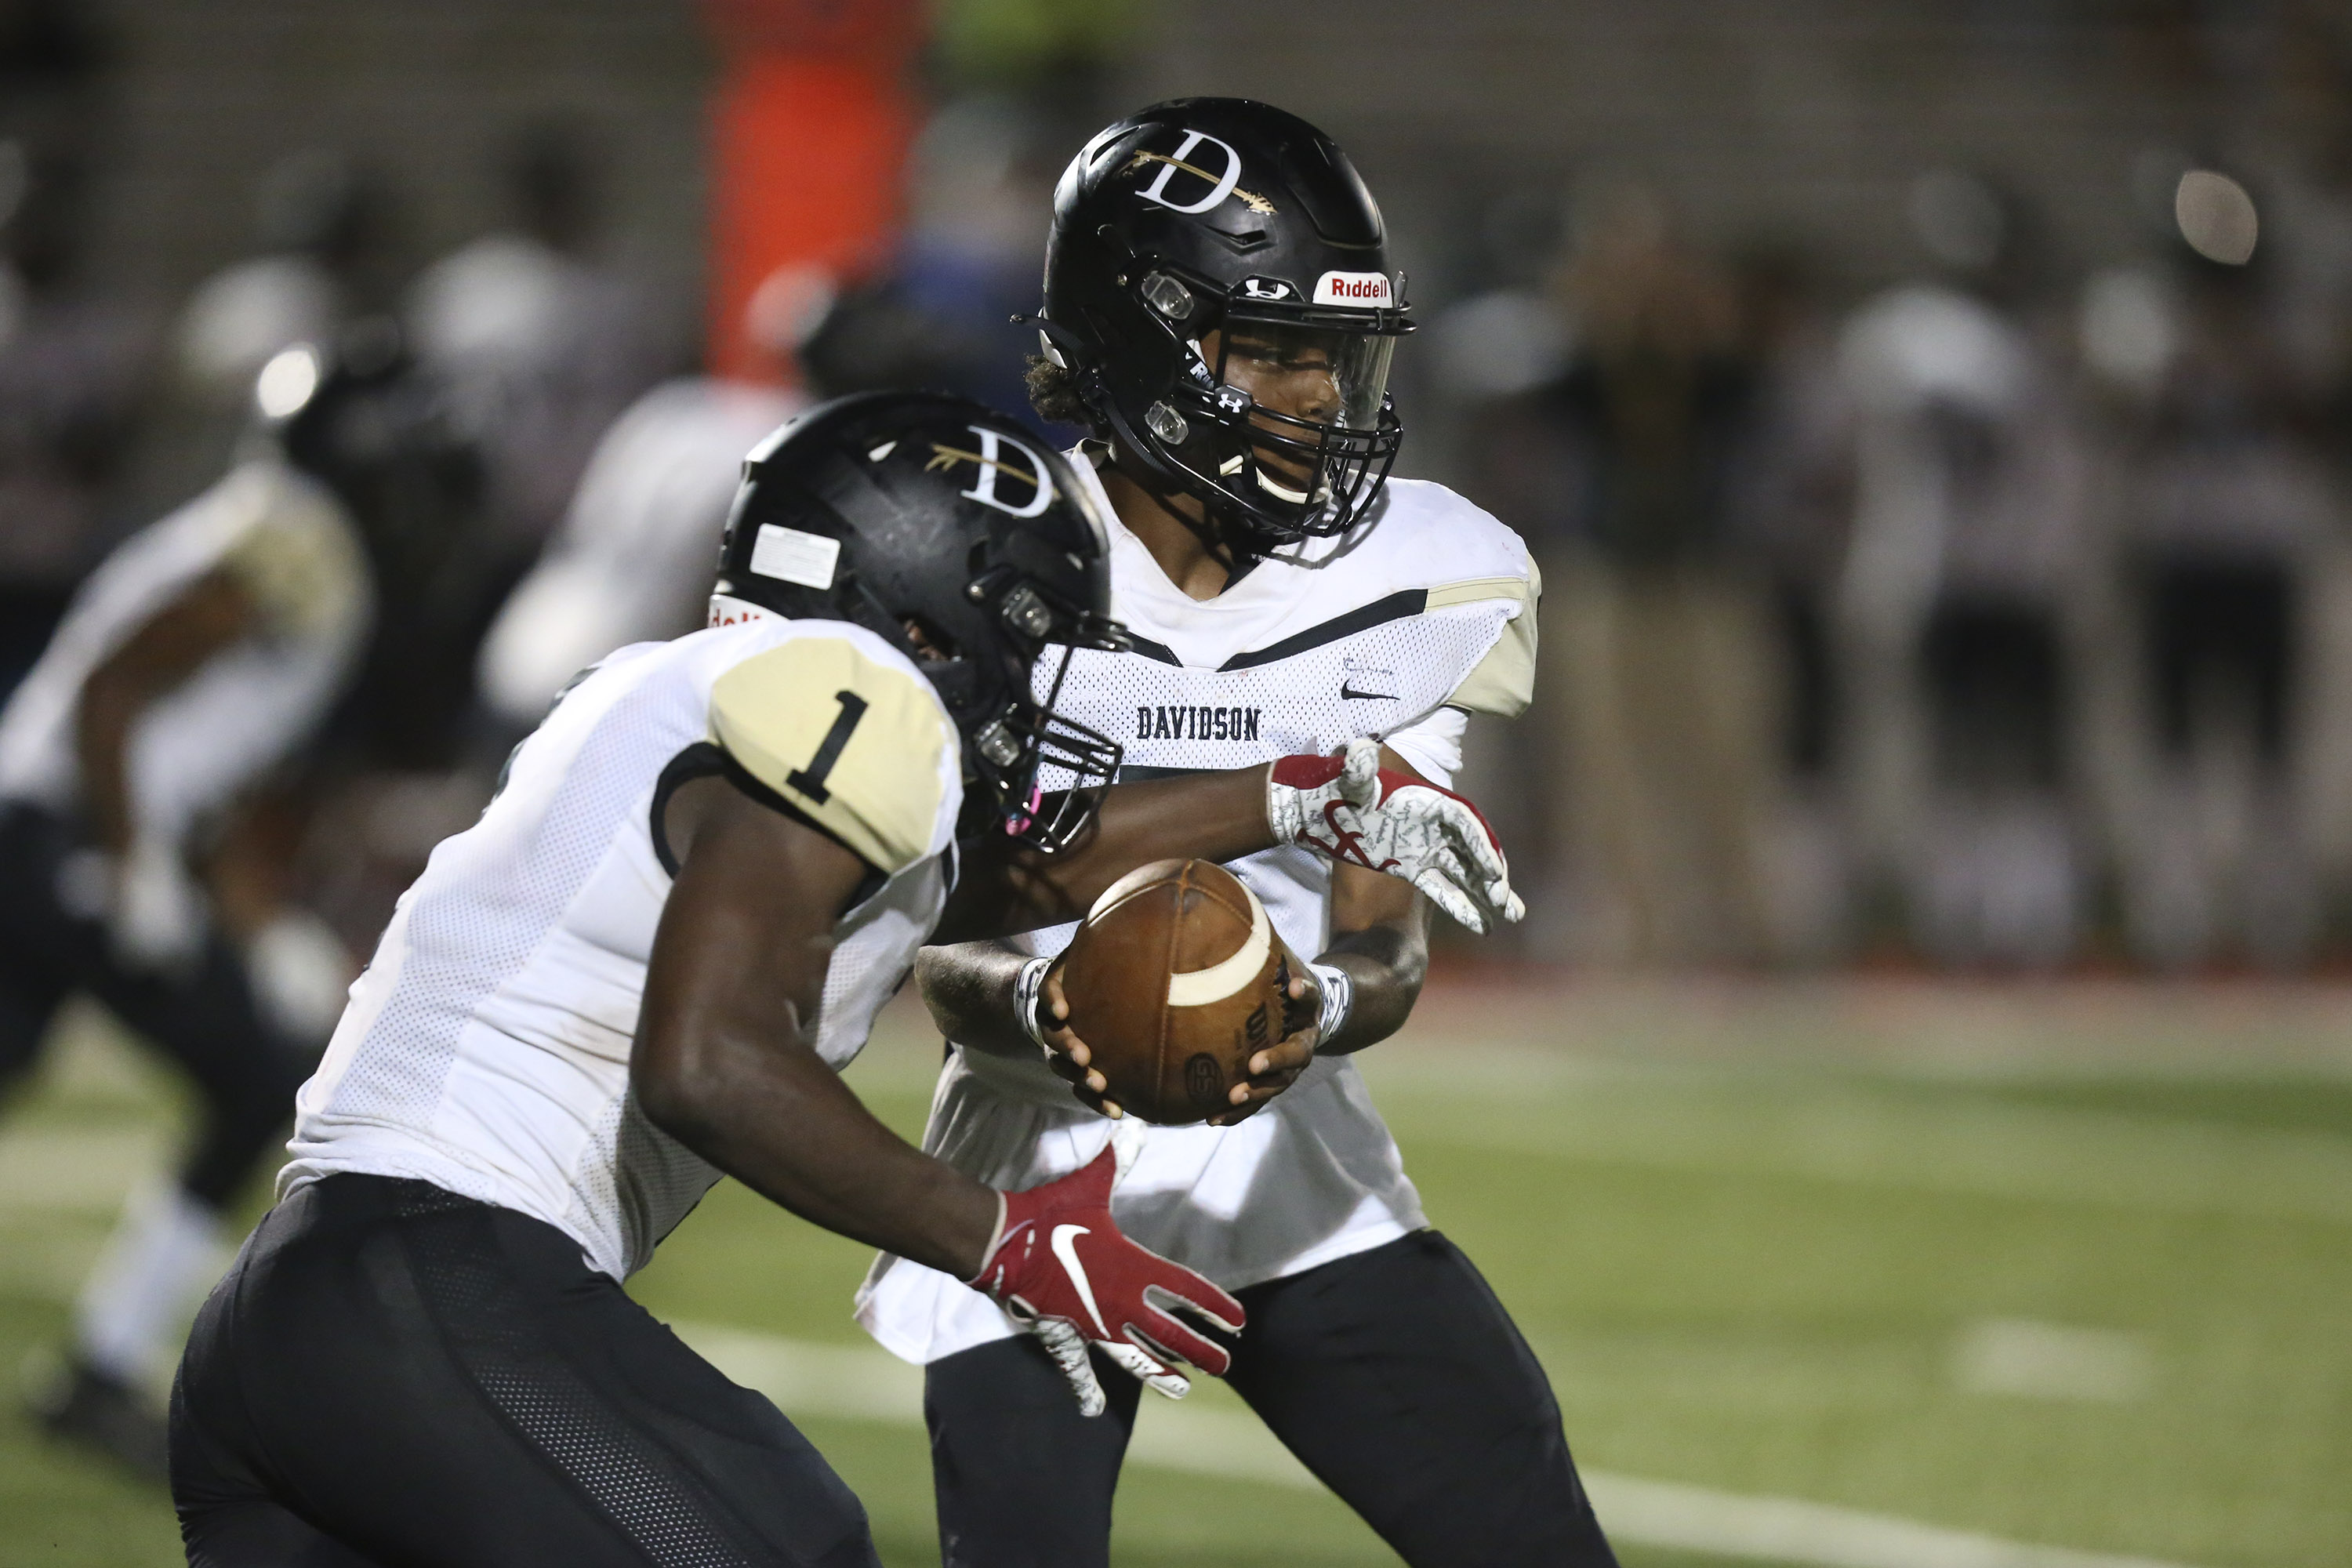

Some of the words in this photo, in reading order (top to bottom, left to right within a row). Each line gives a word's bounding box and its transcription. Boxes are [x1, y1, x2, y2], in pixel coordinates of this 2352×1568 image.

[1134, 128, 1242, 214] D
[1331, 278, 1388, 298] Riddell
[960, 425, 1054, 518] D
[786, 689, 869, 806] 1
[1137, 705, 1262, 741] DAVIDSON
